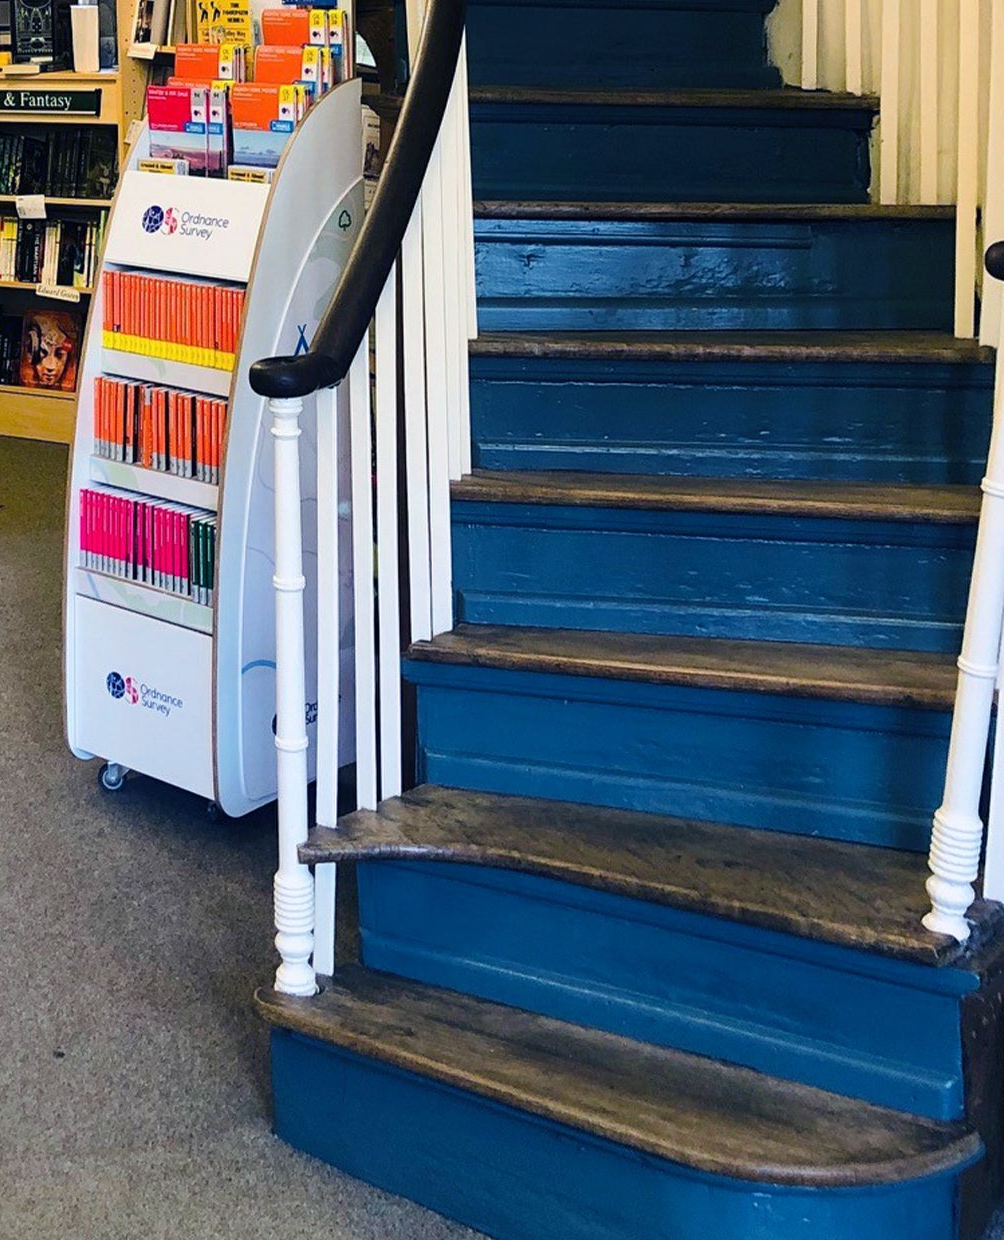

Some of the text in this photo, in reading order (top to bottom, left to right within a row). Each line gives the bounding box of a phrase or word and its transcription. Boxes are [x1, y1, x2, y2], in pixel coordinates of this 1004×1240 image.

[3, 92, 16, 106] &
[20, 91, 72, 110] Fantasy
[181, 212, 230, 229] Ordnance
[179, 224, 213, 240] Survey
[141, 683, 183, 708] Ordnance
[141, 696, 171, 717] Survey
